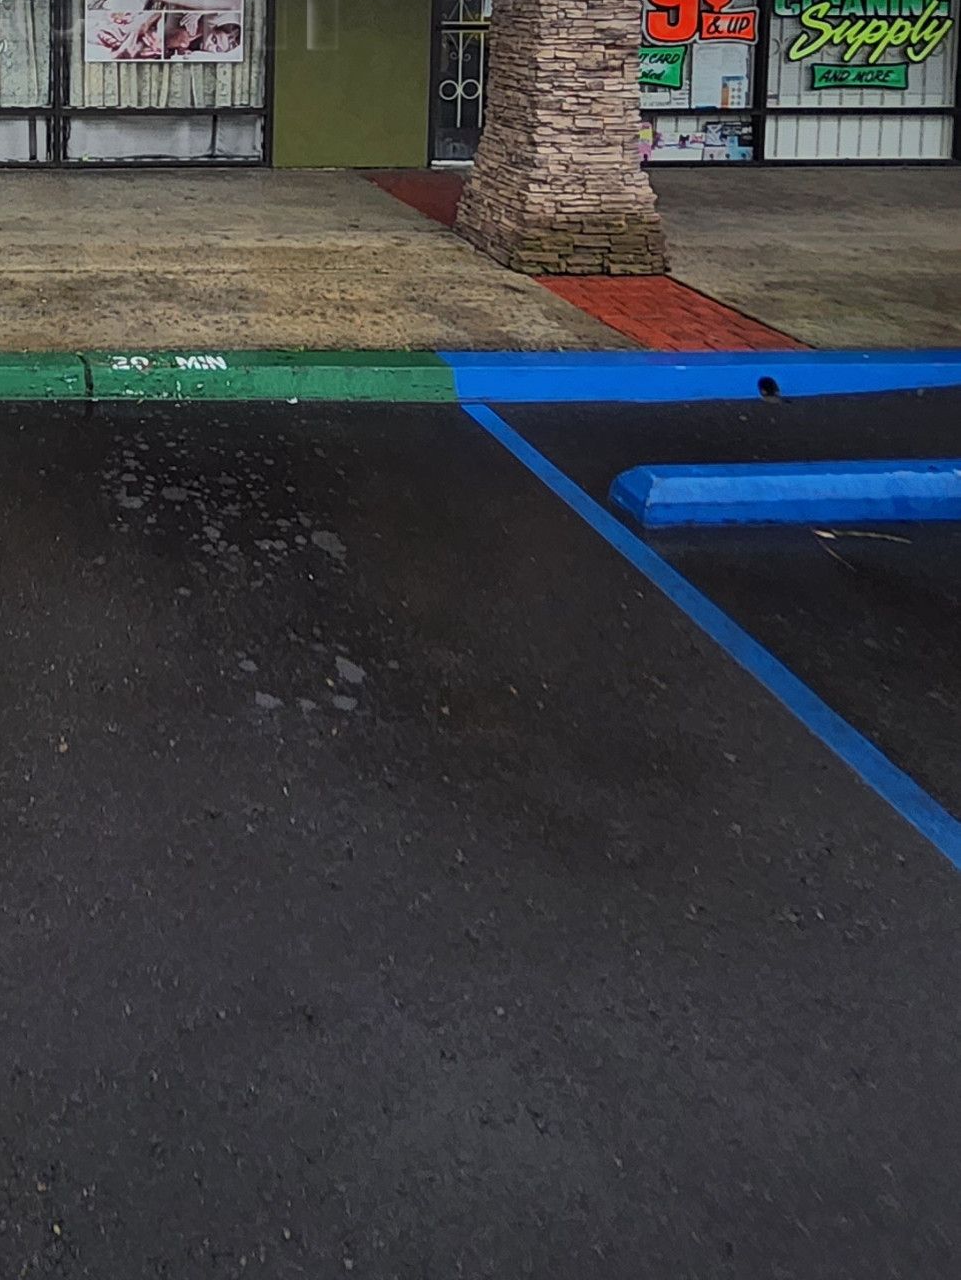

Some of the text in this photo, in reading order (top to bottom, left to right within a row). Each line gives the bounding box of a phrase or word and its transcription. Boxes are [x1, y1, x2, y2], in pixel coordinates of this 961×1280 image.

[705, 15, 750, 36] & UP
[789, 0, 954, 64] Supply
[649, 52, 681, 65] CARD
[818, 69, 895, 83] AND MORE
[110, 354, 228, 371] 20 MIN
